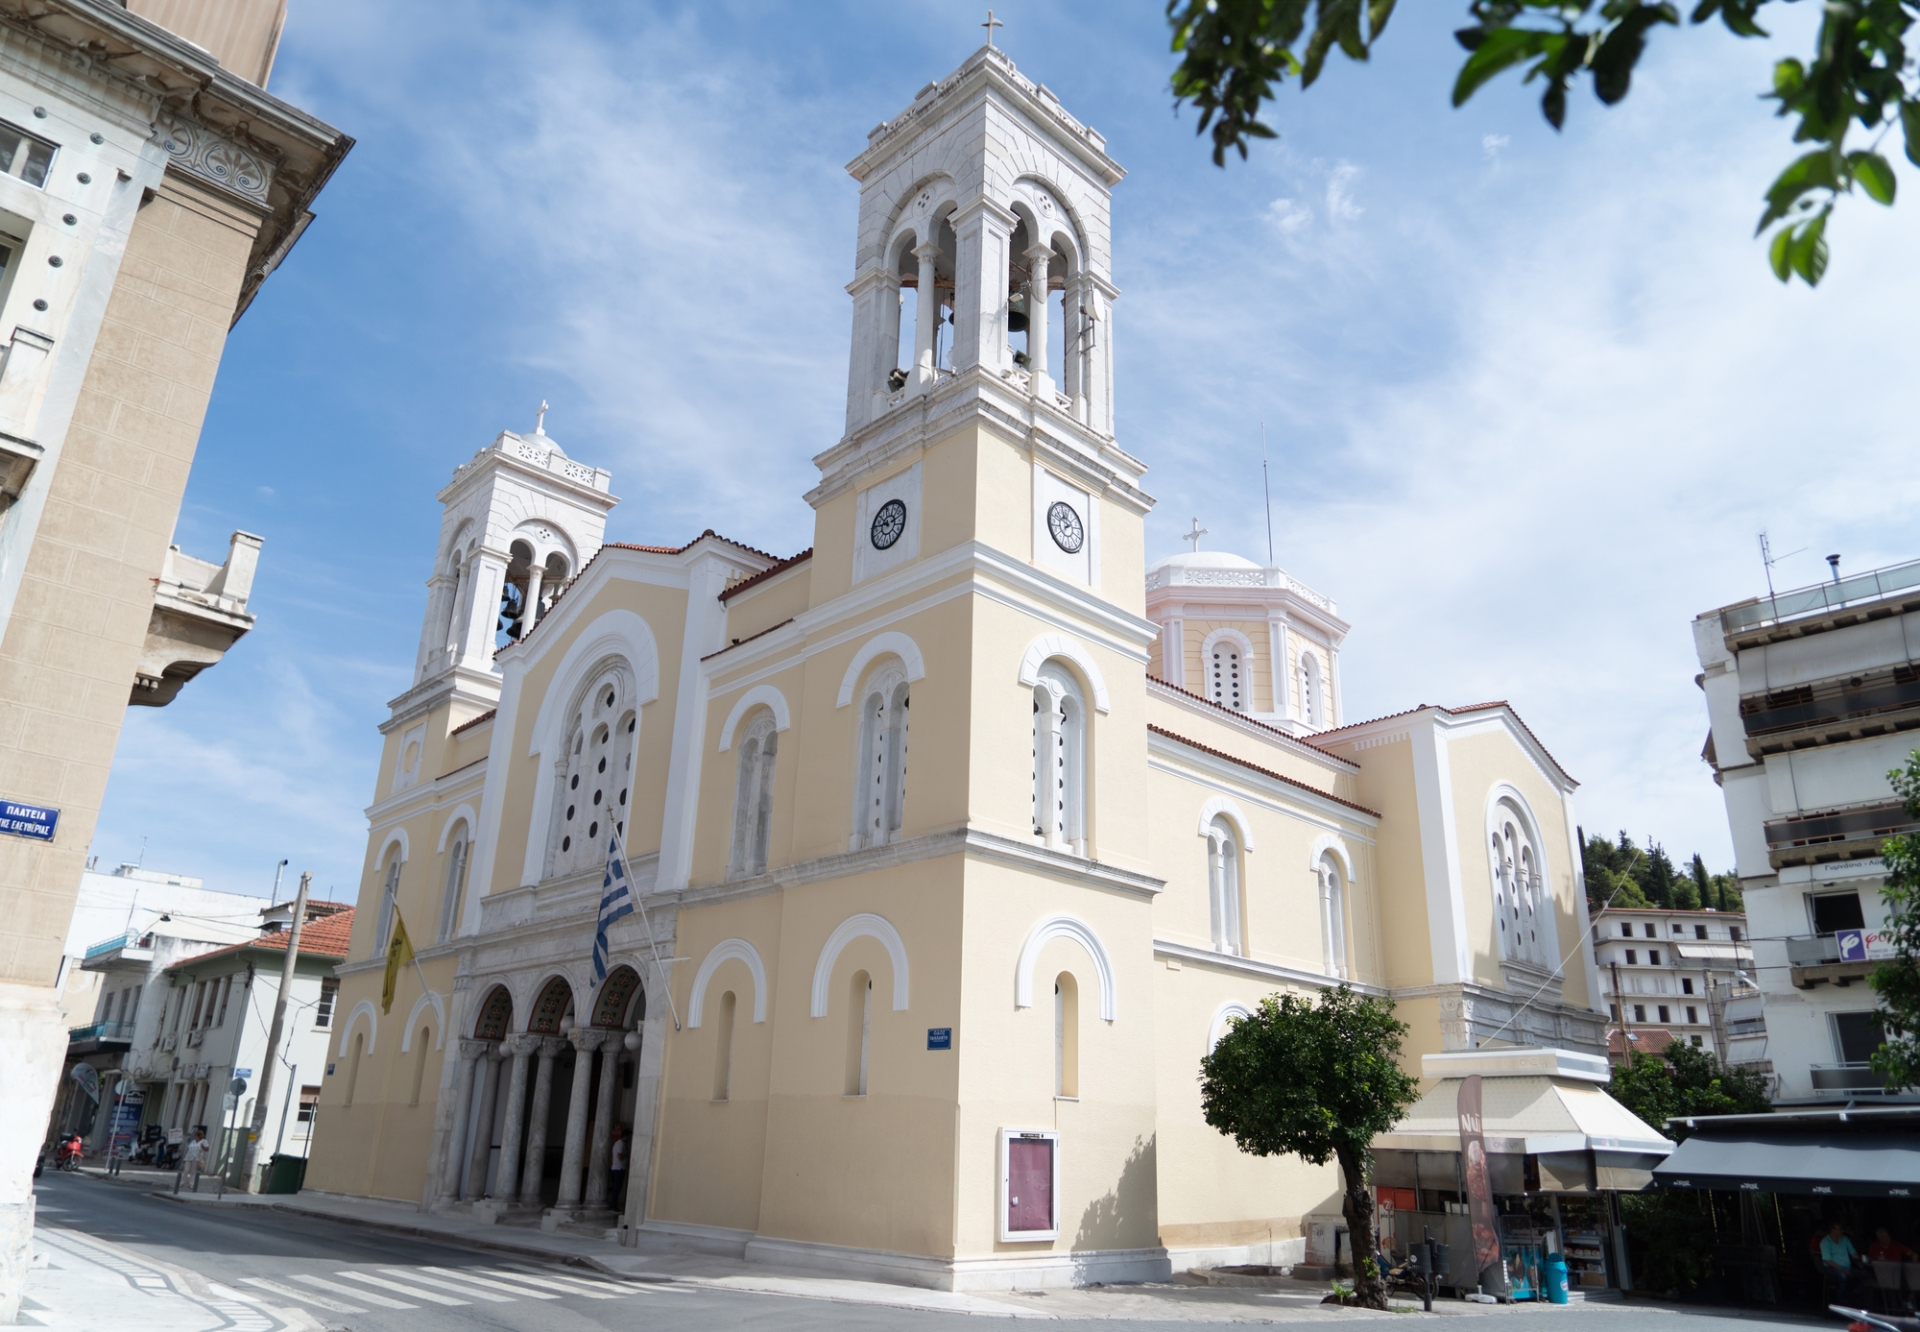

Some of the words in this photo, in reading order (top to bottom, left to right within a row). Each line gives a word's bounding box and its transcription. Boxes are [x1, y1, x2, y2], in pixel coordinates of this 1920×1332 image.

[6, 805, 46, 820] ΠΛΑΤΕΙΑ
[11, 820, 50, 835] ΕΛΕΥΘΕΡΙΑΣ
[1825, 861, 1862, 871] Γυμνάσιο
[1493, 1141, 1508, 1149] ONE
